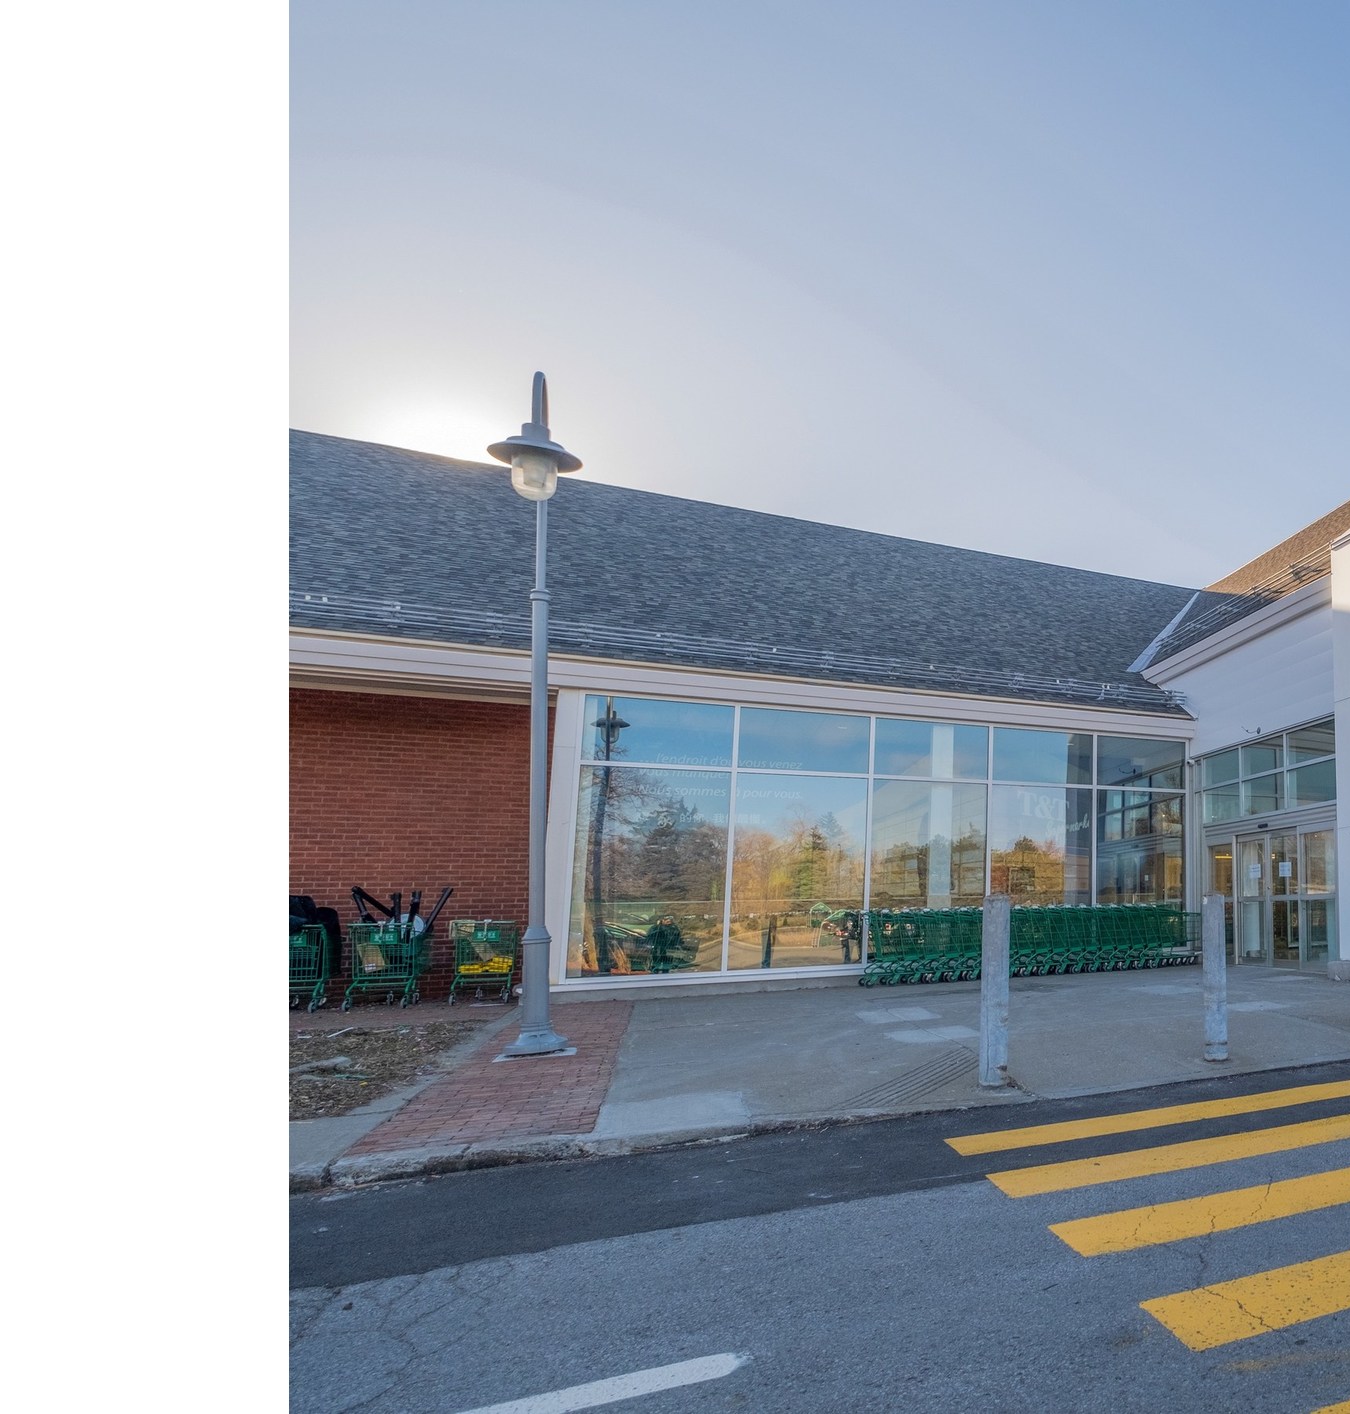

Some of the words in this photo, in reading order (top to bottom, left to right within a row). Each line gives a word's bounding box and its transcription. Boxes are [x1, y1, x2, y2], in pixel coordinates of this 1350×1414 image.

[769, 760, 803, 769] venez
[639, 785, 672, 796] Nous
[674, 786, 728, 797] sommes
[742, 789, 772, 799] pour
[1016, 789, 1070, 821] T&T
